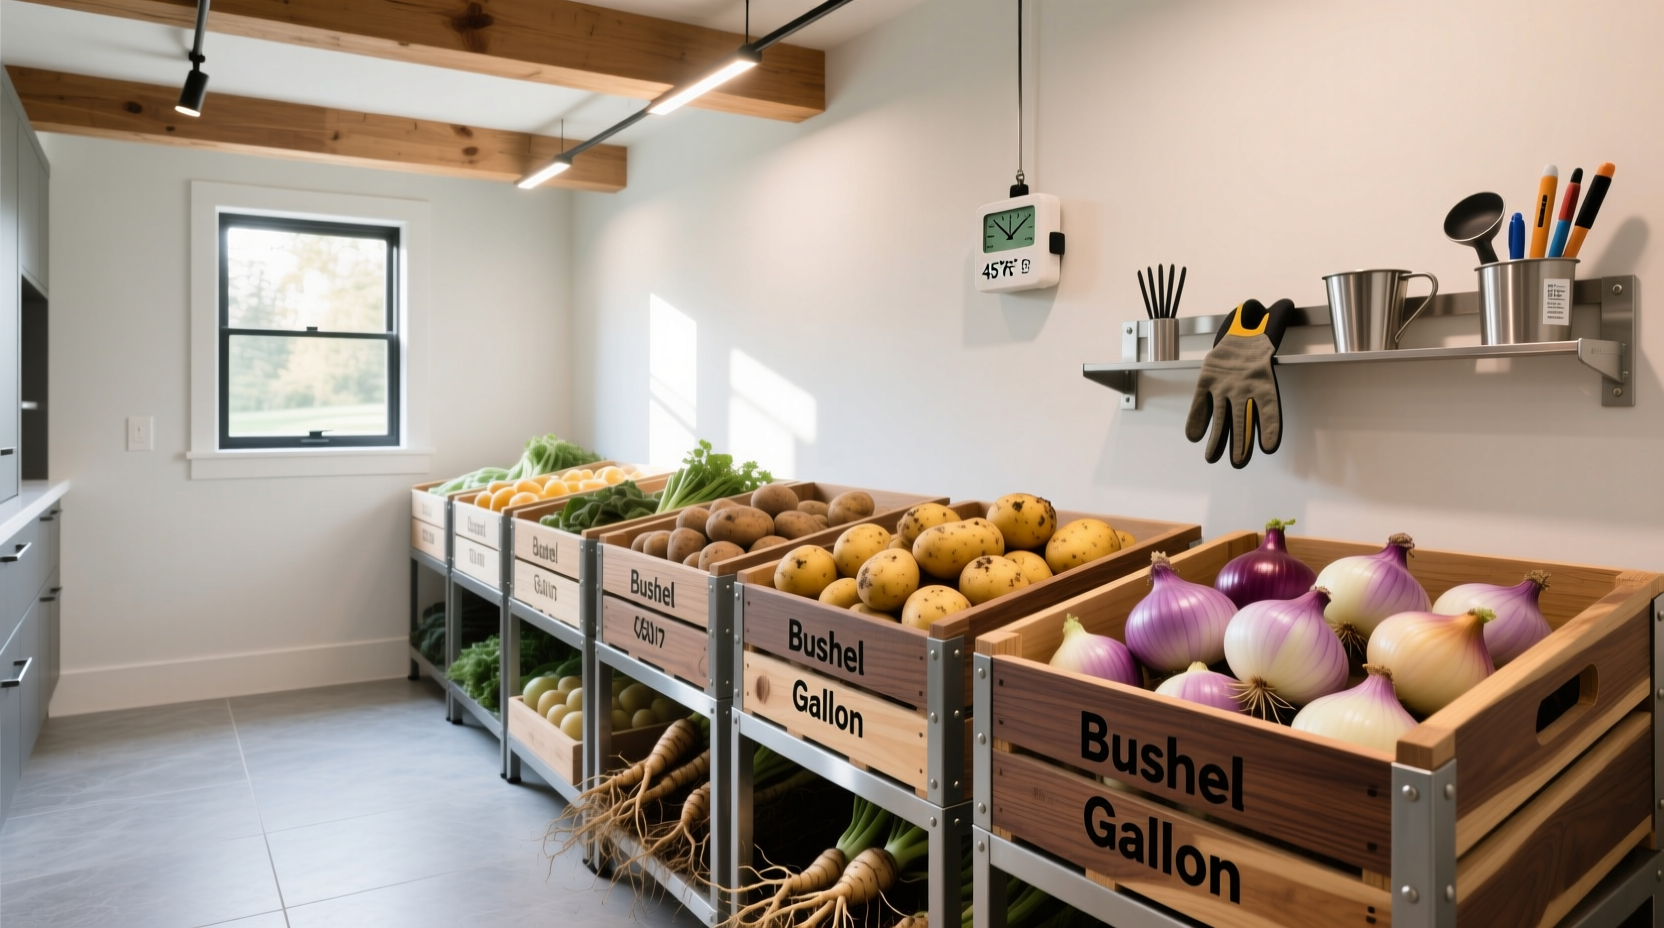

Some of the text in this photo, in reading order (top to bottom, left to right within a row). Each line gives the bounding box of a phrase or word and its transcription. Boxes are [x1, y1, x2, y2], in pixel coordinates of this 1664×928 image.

[630, 569, 675, 608] Bushel
[788, 618, 865, 676] Bushel
[792, 679, 863, 738] Gallon
[1081, 710, 1244, 812] Bushel
[1083, 796, 1241, 905] Gallon
